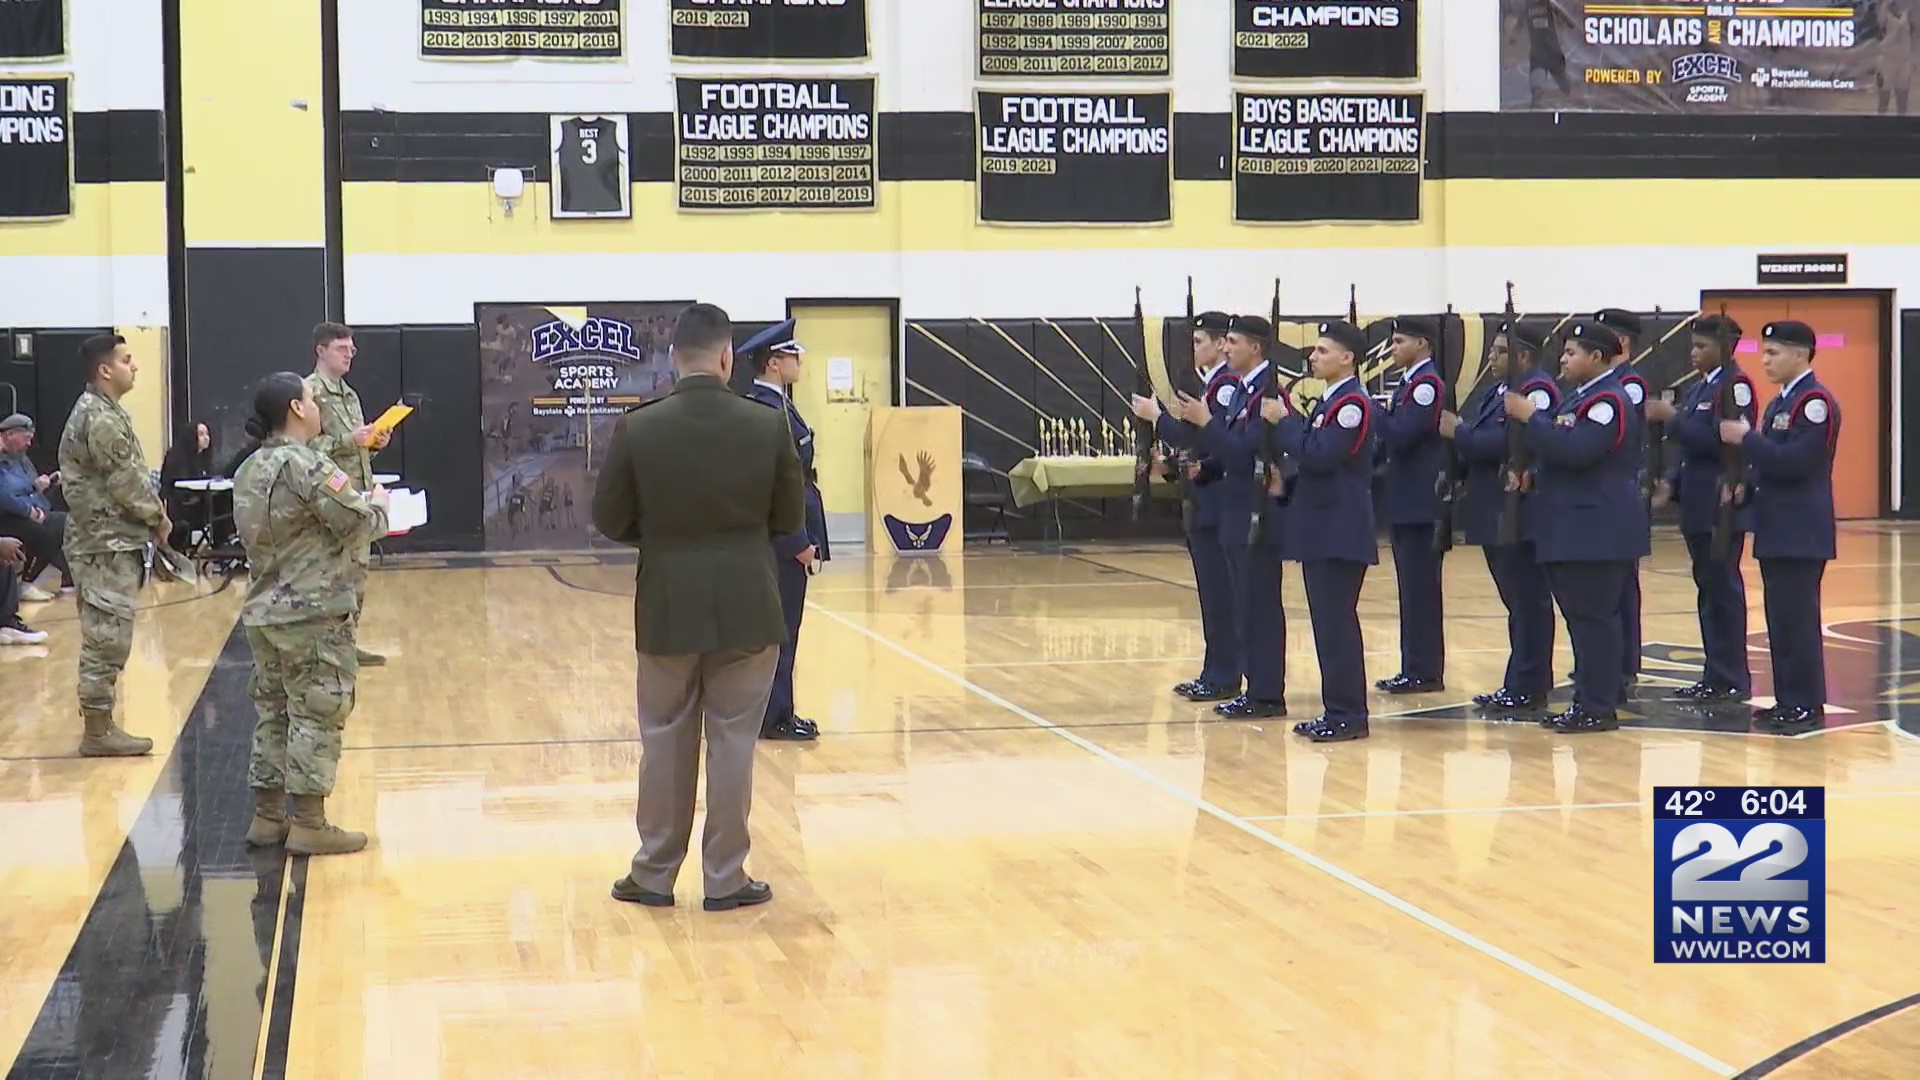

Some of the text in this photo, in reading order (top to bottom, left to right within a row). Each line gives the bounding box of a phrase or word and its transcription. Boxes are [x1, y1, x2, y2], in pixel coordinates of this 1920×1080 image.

[427, 10, 614, 25] 1993 1994 1996 1997 2001
[676, 12, 746, 25] 2019 2021
[986, 14, 1162, 27] 1987 1988 1989 1990 1991
[1253, 6, 1399, 26] CHAMPIONS
[1584, 18, 1702, 46] SCHOLARS
[1727, 19, 1855, 47] CHAMPIONS
[426, 33, 616, 47] 2012 2013 2015 2017 2018
[986, 36, 1164, 48] 1992 1994 1999 2007 2008
[1239, 34, 1306, 46] 2021 2022
[985, 57, 1164, 70] 2009 2011 2012 2013 2017
[1672, 53, 1742, 83] EXCEL
[1585, 69, 1663, 84] POWERED BY
[1833, 79, 1855, 88] Care
[701, 83, 850, 110] FOOTBALL
[1690, 85, 1725, 94] SPORTS
[0, 84, 55, 112] DING
[1686, 94, 1728, 102] ACADEMY
[1002, 97, 1146, 124] FOOTBALL
[1243, 97, 1416, 124] BOYS BASKETBALL
[579, 128, 599, 138] BEST
[682, 114, 869, 140] LEAGUE CHAMPIONS
[982, 126, 1168, 154] LEAGUE CHAMPIONS
[1240, 126, 1418, 153] LEAGUE CHAMPIONS
[581, 138, 597, 164] 3
[685, 146, 867, 160] 1992 1993 1994 1996 1997
[986, 159, 1053, 172] 2019 2021
[1241, 159, 1416, 172] 2018 2019 2020 2021 2022
[684, 167, 867, 180] 2000 2011 2012 2013 2014
[684, 188, 868, 202] 2015 2016 2017 2018 2019
[1760, 264, 1803, 272] WEIGHT
[1804, 264, 1836, 272] ROOM
[532, 317, 640, 361] EXCEL
[560, 366, 614, 378] SPORTS
[554, 378, 619, 390] ACADEMY
